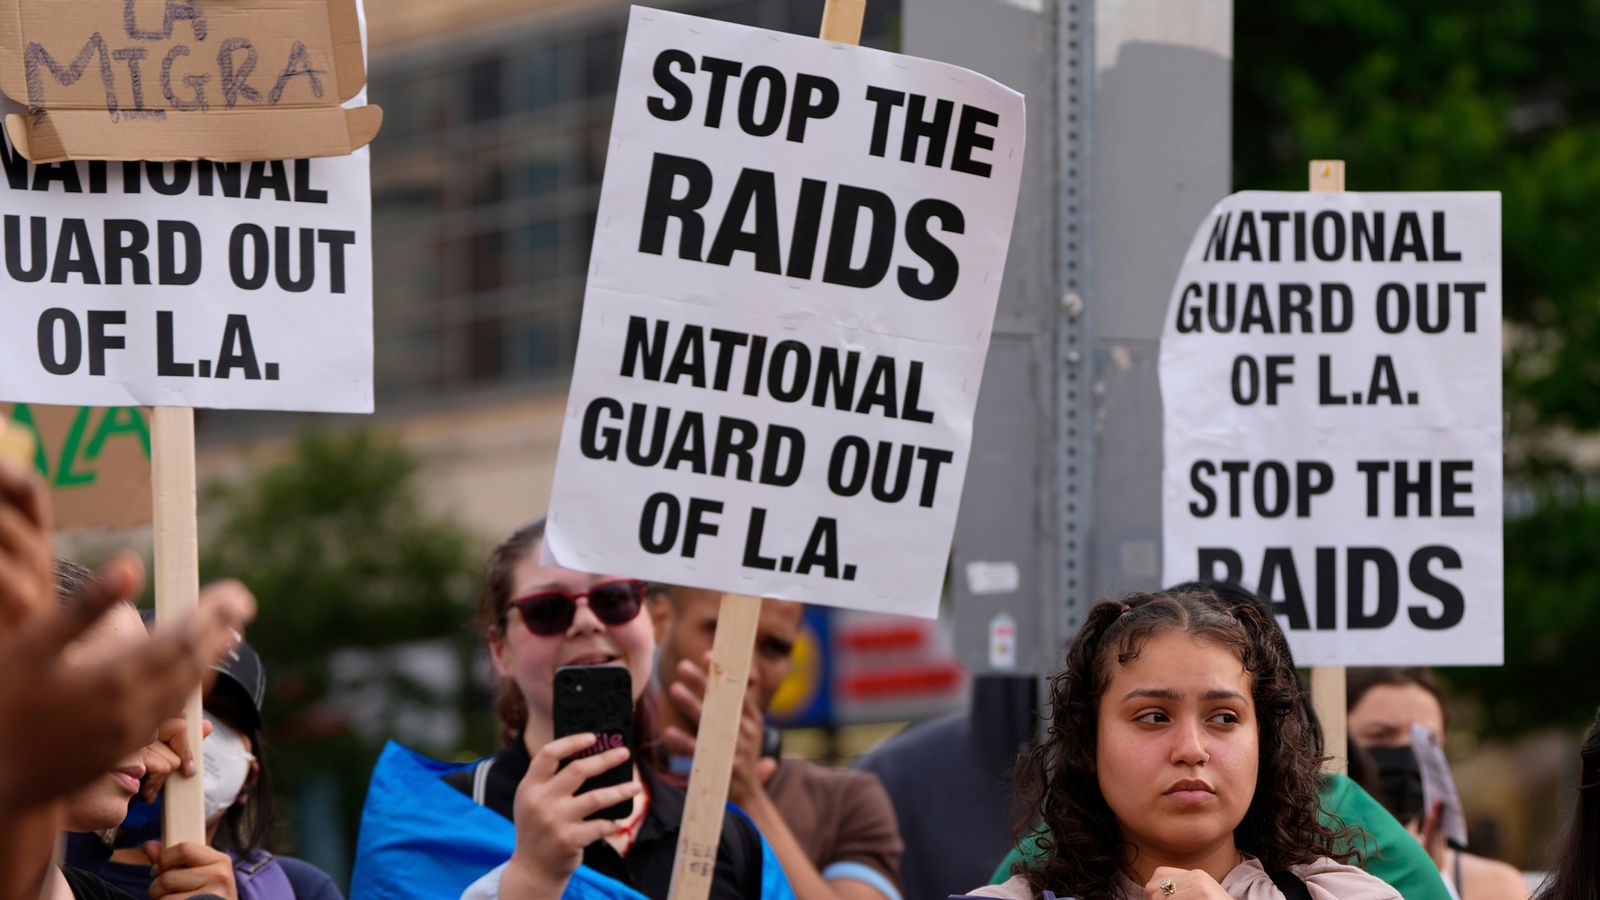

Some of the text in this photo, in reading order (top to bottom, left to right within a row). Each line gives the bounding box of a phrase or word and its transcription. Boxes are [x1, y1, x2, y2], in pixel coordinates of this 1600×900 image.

[123, 0, 208, 41] LA
[24, 32, 327, 127] MIGRA
[646, 48, 1000, 179] STOP THE
[3, 214, 356, 294] UARD OUT
[637, 151, 966, 302] RAIDS
[1203, 210, 1462, 263] NATIONAL
[37, 307, 280, 381] OF L.A.
[1175, 282, 1487, 335] GUARD OUT
[619, 315, 935, 425] NATIONAL
[1230, 354, 1419, 406] OF L.A.
[579, 396, 954, 509] GUARD OUT
[1188, 459, 1475, 519] STOP THE
[638, 491, 858, 582] OF L.A.
